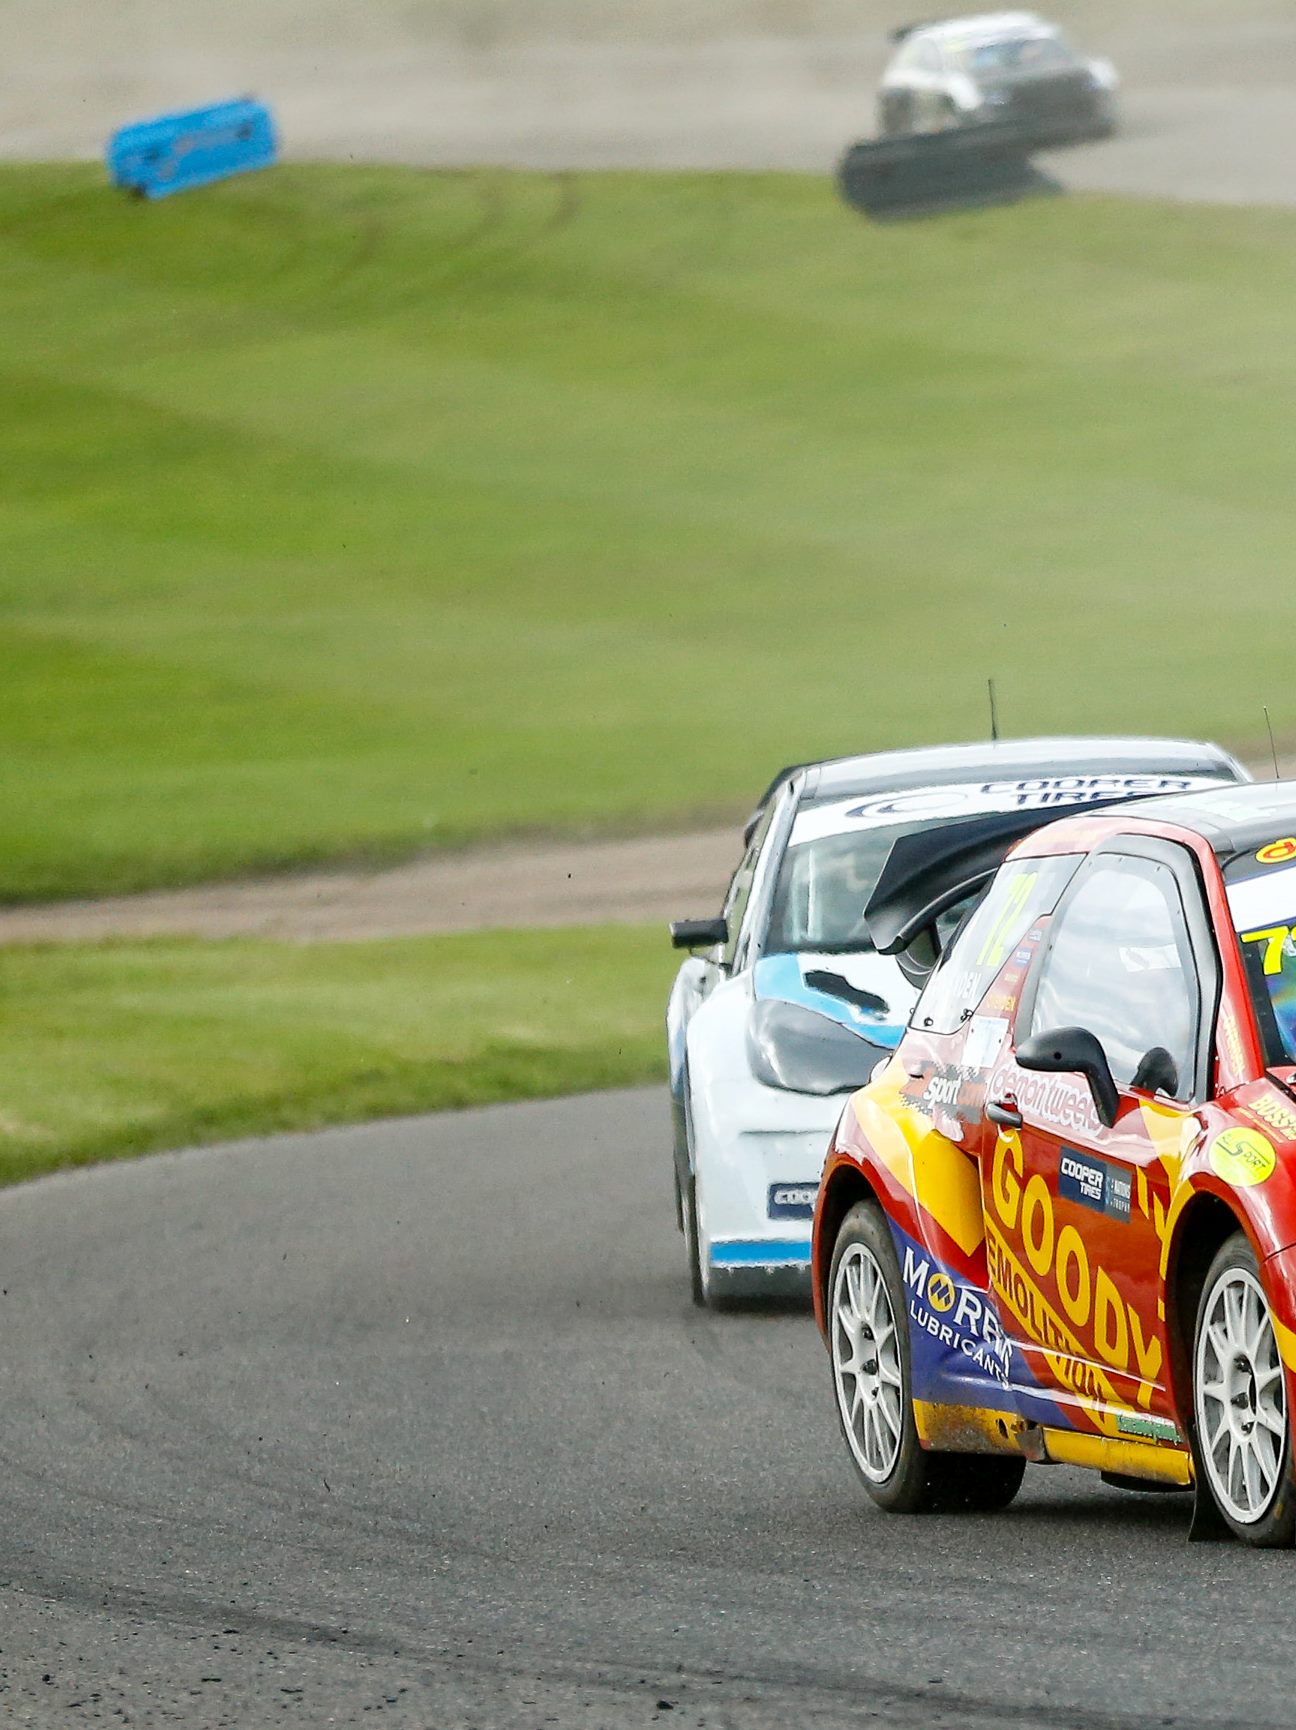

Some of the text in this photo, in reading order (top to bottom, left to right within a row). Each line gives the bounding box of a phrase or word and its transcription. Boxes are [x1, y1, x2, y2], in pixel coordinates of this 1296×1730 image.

[981, 778, 1193, 794] COOPER
[1060, 1157, 1105, 1191] COOPER
[1079, 1181, 1103, 1201] TIRES
[992, 1130, 1163, 1410] GOODY
